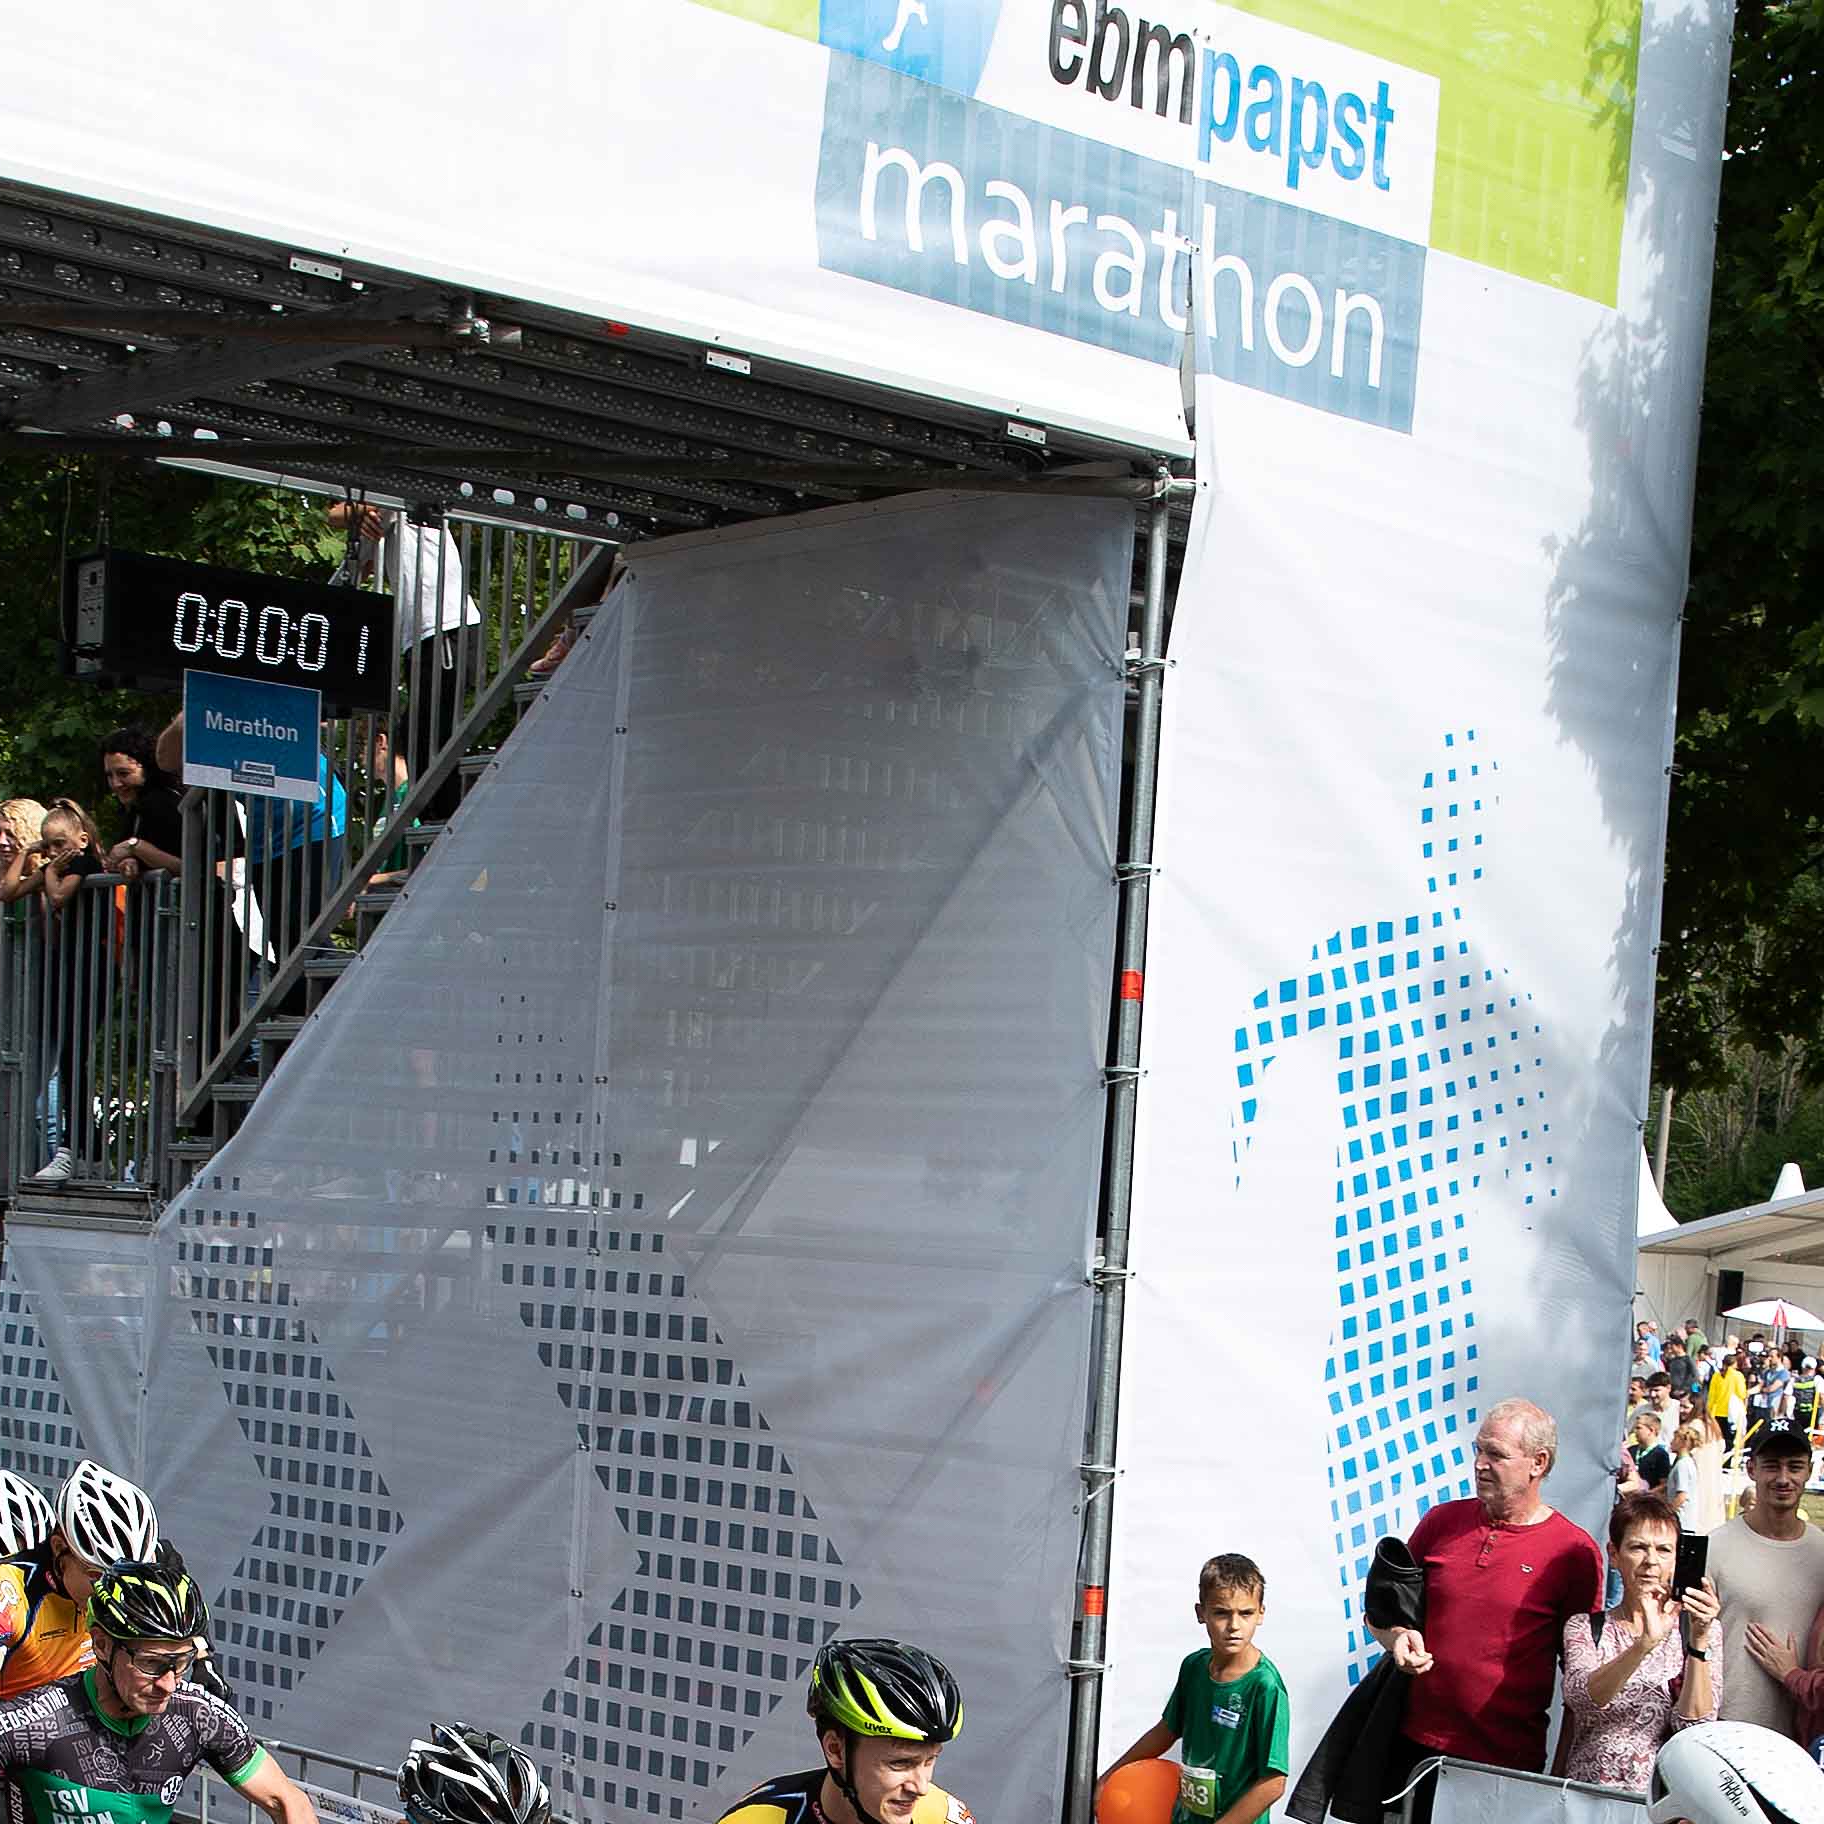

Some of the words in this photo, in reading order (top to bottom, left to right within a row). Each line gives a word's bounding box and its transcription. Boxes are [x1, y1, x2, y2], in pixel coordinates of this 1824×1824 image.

[1047, 0, 1393, 191] ebmpapst
[858, 140, 1382, 388] marathon
[173, 590, 368, 675] 0:00:01
[205, 710, 298, 742] Marathon
[865, 1721, 894, 1735] uvex
[45, 1787, 89, 1814] TSV
[410, 1794, 454, 1822] RUDY
